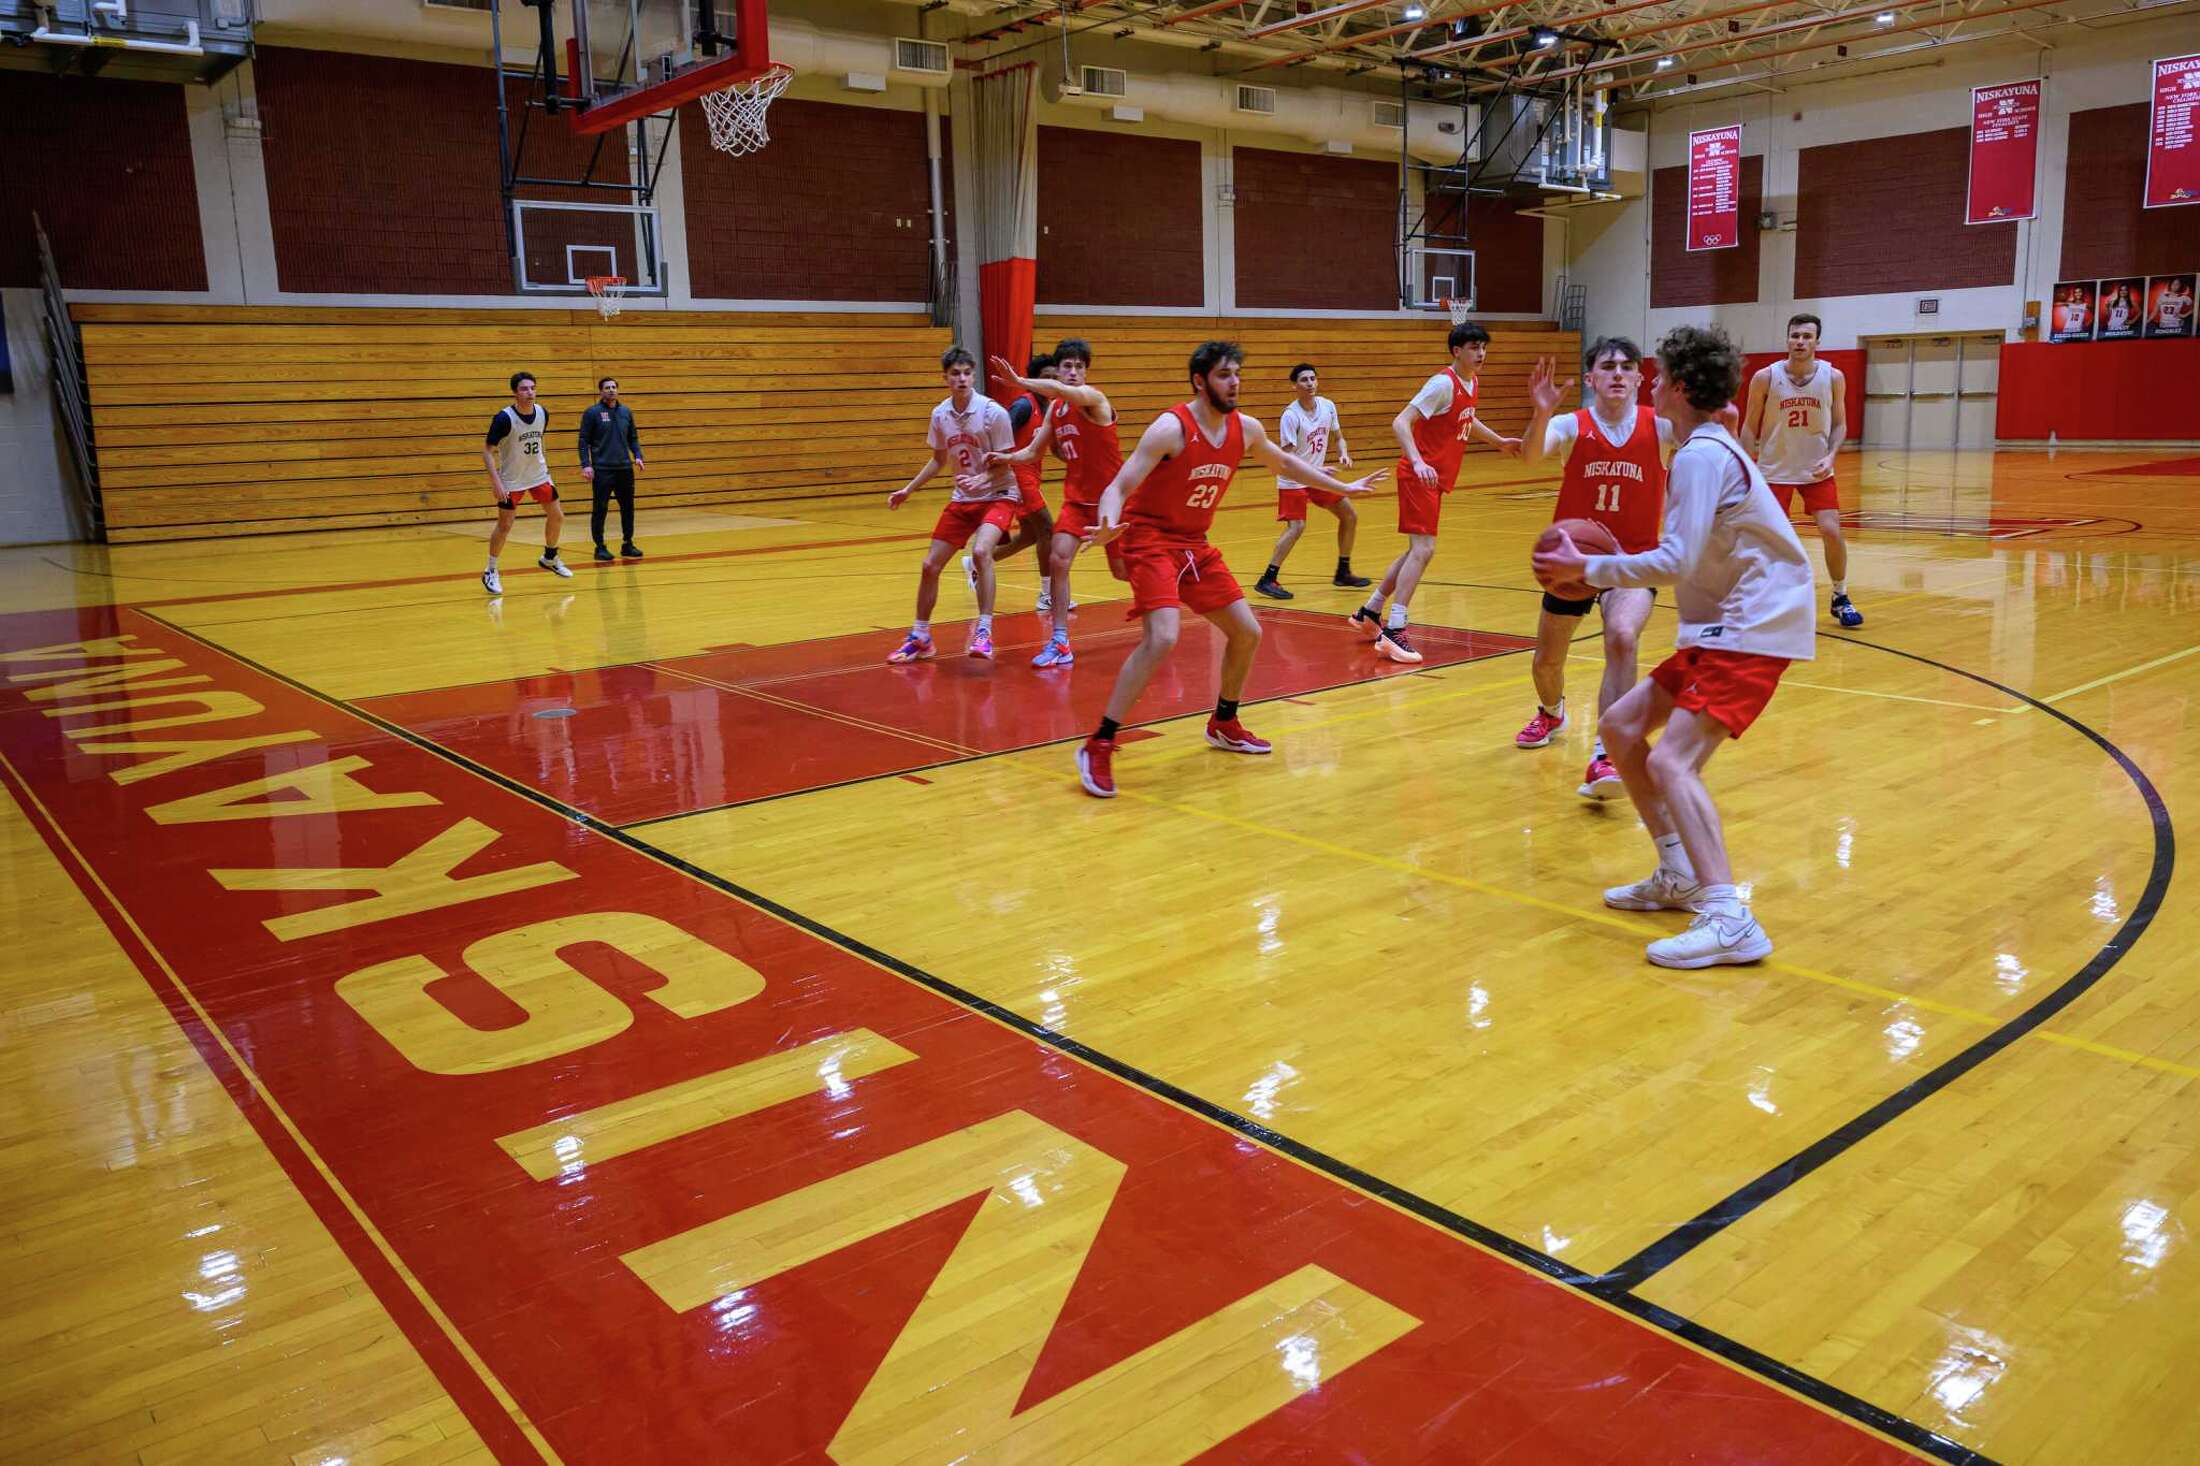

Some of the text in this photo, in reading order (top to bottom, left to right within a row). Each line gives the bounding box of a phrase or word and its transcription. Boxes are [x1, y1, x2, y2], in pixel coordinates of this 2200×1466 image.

[1976, 84, 2038, 104] NISKAYUNA
[1692, 130, 1738, 147] NISKAYUNA
[1788, 410, 1809, 428] 21
[523, 442, 540, 455] 32
[1310, 438, 1324, 454] 15
[958, 449, 971, 467] 2
[1583, 460, 1644, 482] NISKAYUNA
[1186, 484, 1219, 509] 23
[1594, 483, 1621, 512] 11
[0, 634, 1424, 1466] NISKAYUNA
